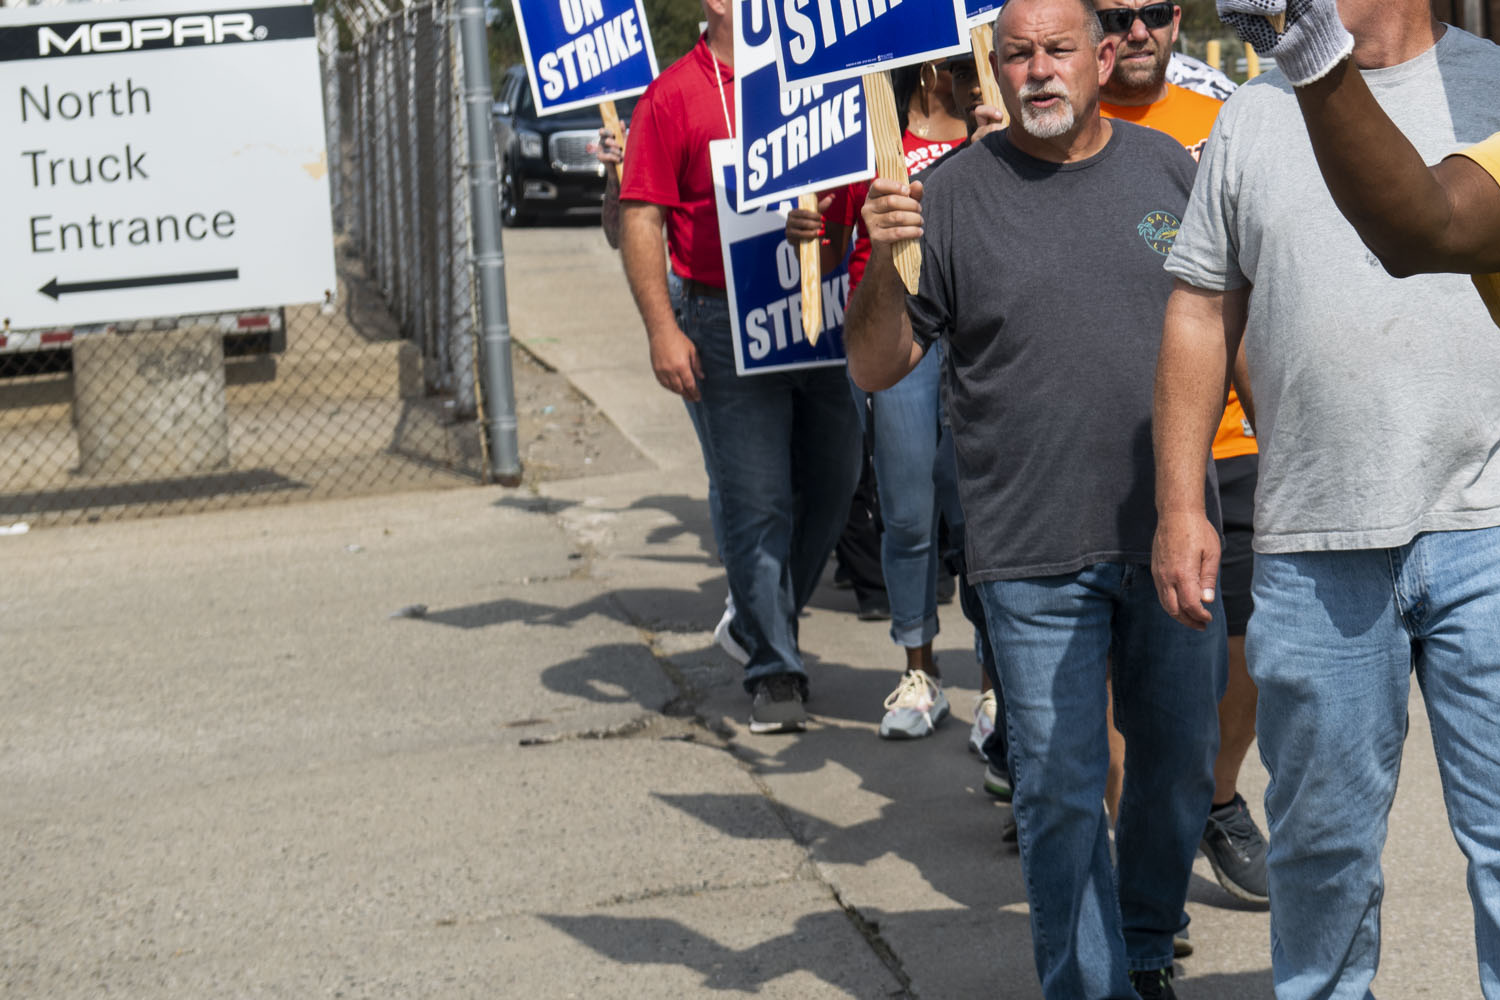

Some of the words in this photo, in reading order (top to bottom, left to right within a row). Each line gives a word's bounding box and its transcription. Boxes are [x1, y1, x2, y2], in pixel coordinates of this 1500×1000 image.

[37, 13, 256, 56] MOPAR
[538, 7, 644, 101] STRIKE
[19, 78, 151, 123] North
[747, 84, 862, 192] STRIKE
[21, 144, 149, 188] Truck
[30, 210, 236, 254] Entrance
[776, 240, 800, 290] O
